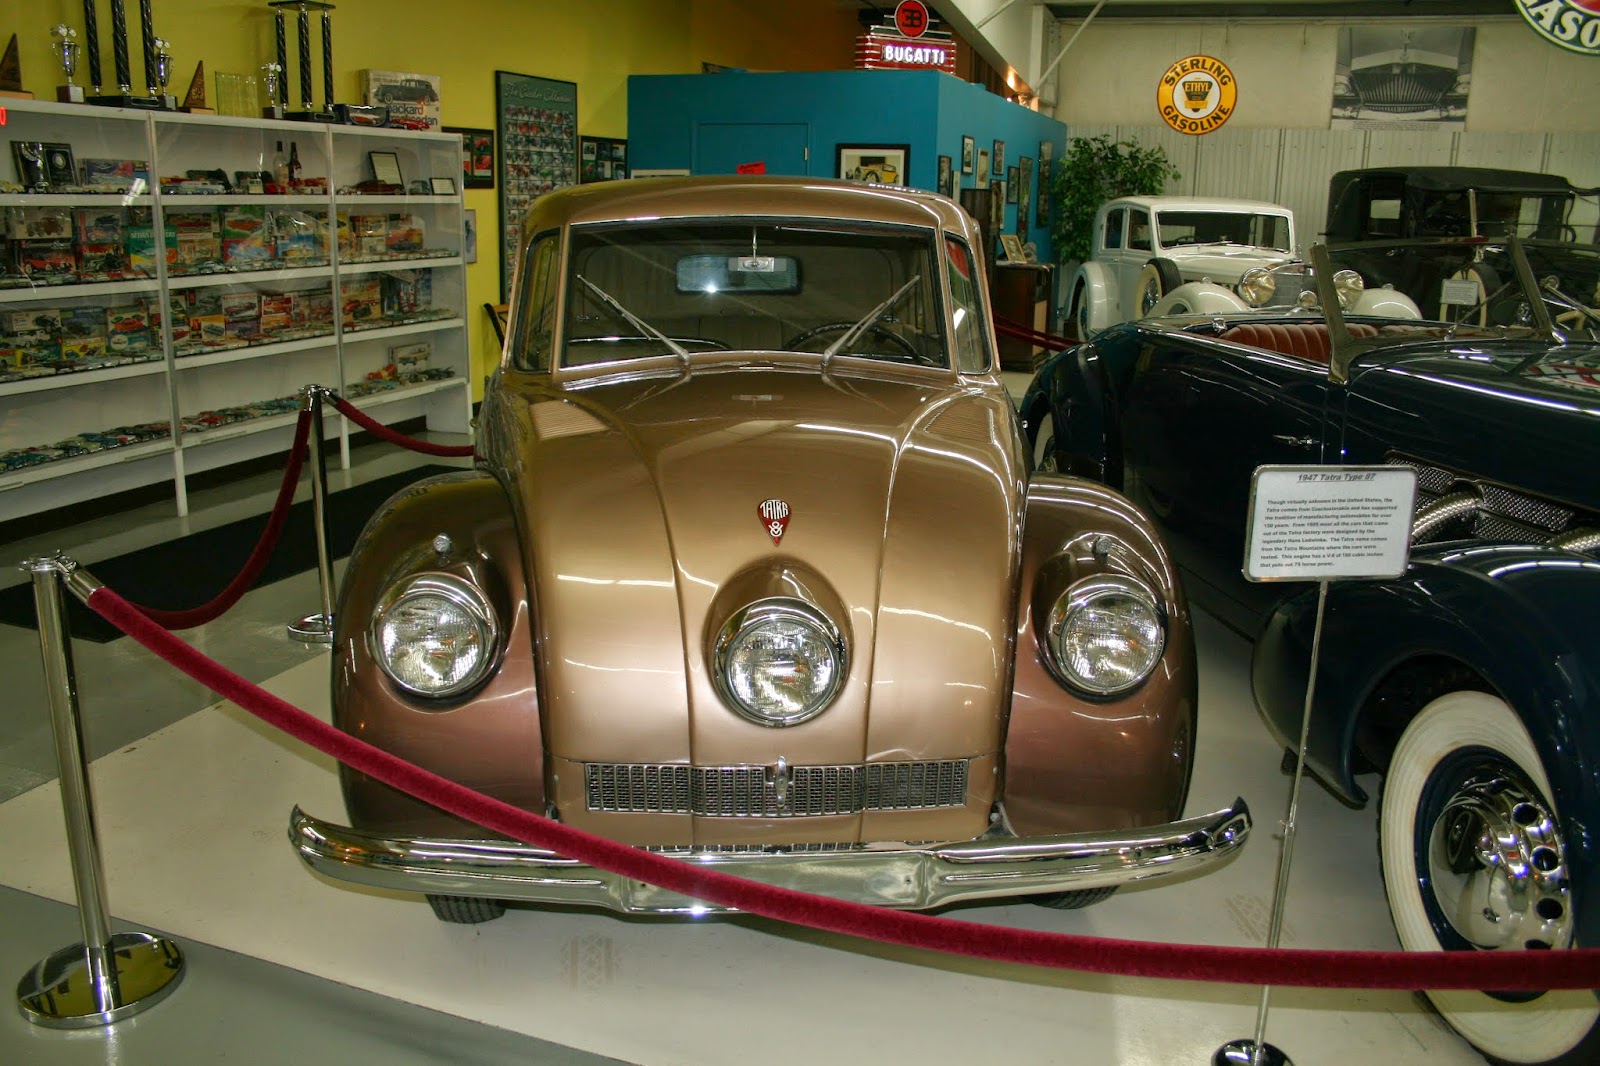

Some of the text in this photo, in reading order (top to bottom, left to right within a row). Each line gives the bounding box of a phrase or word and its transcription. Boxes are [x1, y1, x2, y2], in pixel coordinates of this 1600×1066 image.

[1522, 0, 1600, 48] ASO
[884, 45, 945, 64] BUGATTI
[1165, 58, 1232, 86] STERLING
[1184, 82, 1210, 92] ETHYL
[1163, 105, 1231, 132] GASOLINE
[1343, 473, 1363, 481] Type
[760, 500, 789, 520] TATRA
